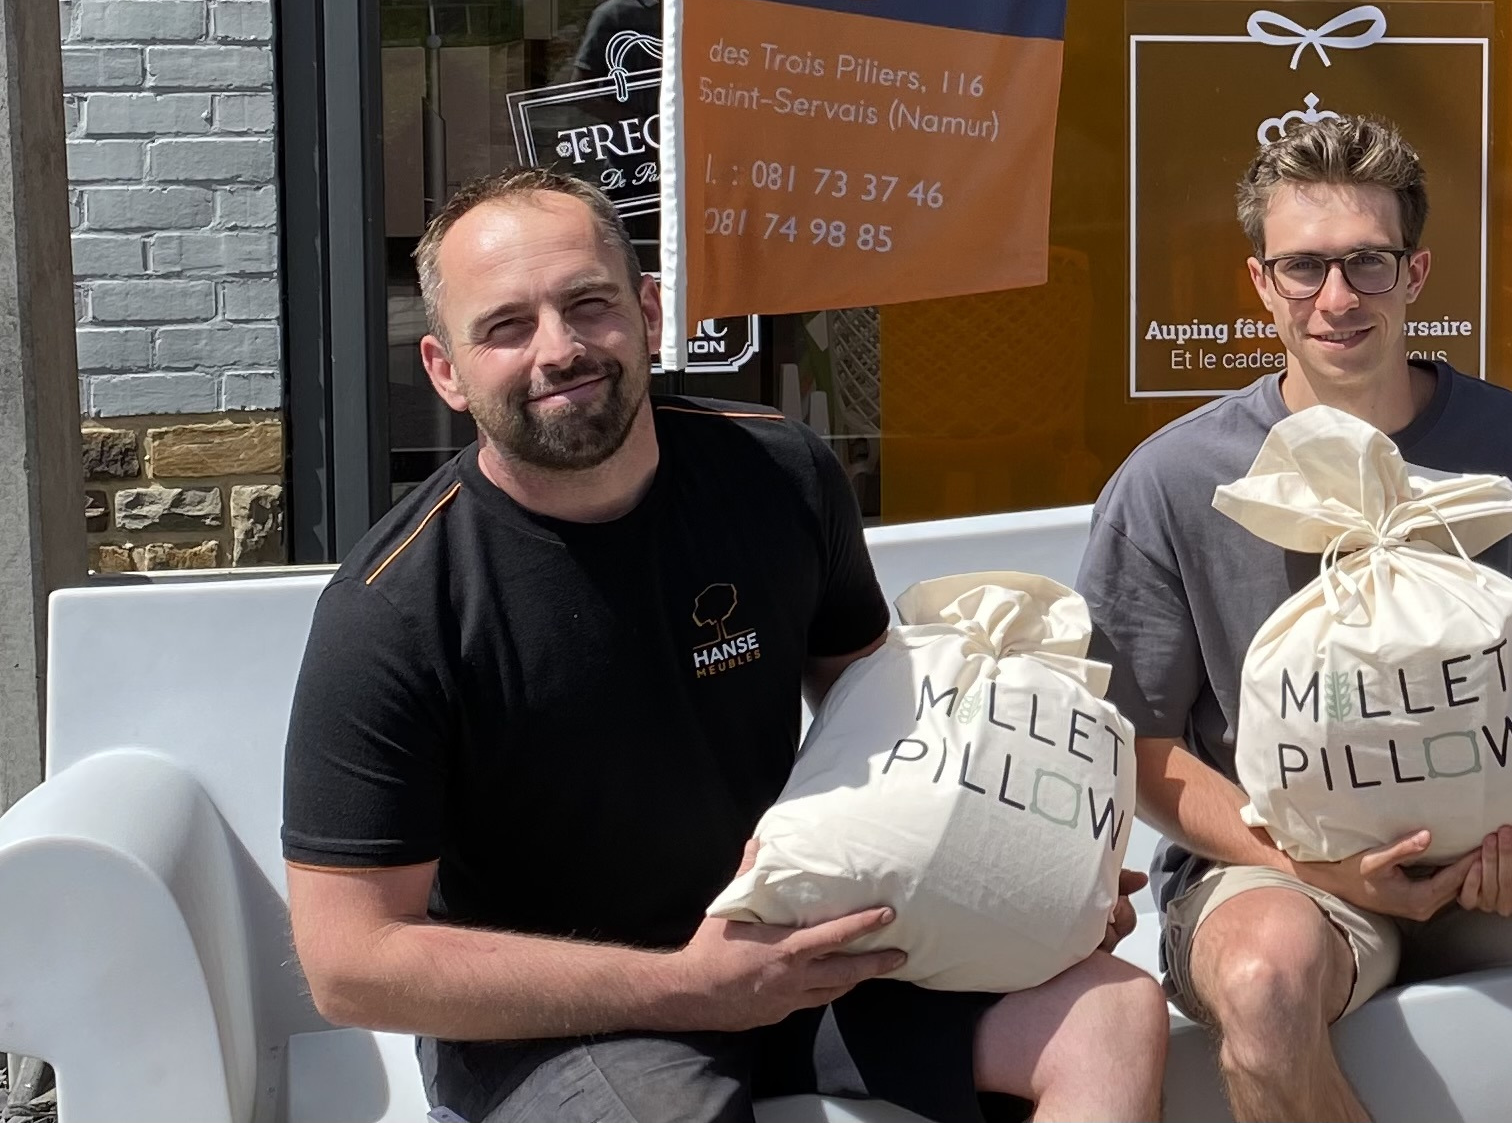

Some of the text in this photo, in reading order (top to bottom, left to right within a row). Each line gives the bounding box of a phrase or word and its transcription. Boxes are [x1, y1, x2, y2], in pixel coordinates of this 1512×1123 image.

[708, 38, 984, 98] des Trois Piliers, 116
[887, 98, 999, 143] (Namur)
[599, 167, 627, 191] De
[751, 159, 796, 193] 081
[813, 168, 849, 199] 73
[861, 173, 899, 203] 37
[908, 179, 944, 210] 46
[704, 207, 893, 253] 081 74 98 85
[1145, 319, 1228, 344] Auping
[1233, 318, 1278, 340] fête
[1170, 350, 1192, 369] Et
[1199, 350, 1217, 369] le
[1405, 350, 1448, 363] ous
[693, 632, 760, 669] HANSE
[696, 649, 761, 679] MEUBLES
